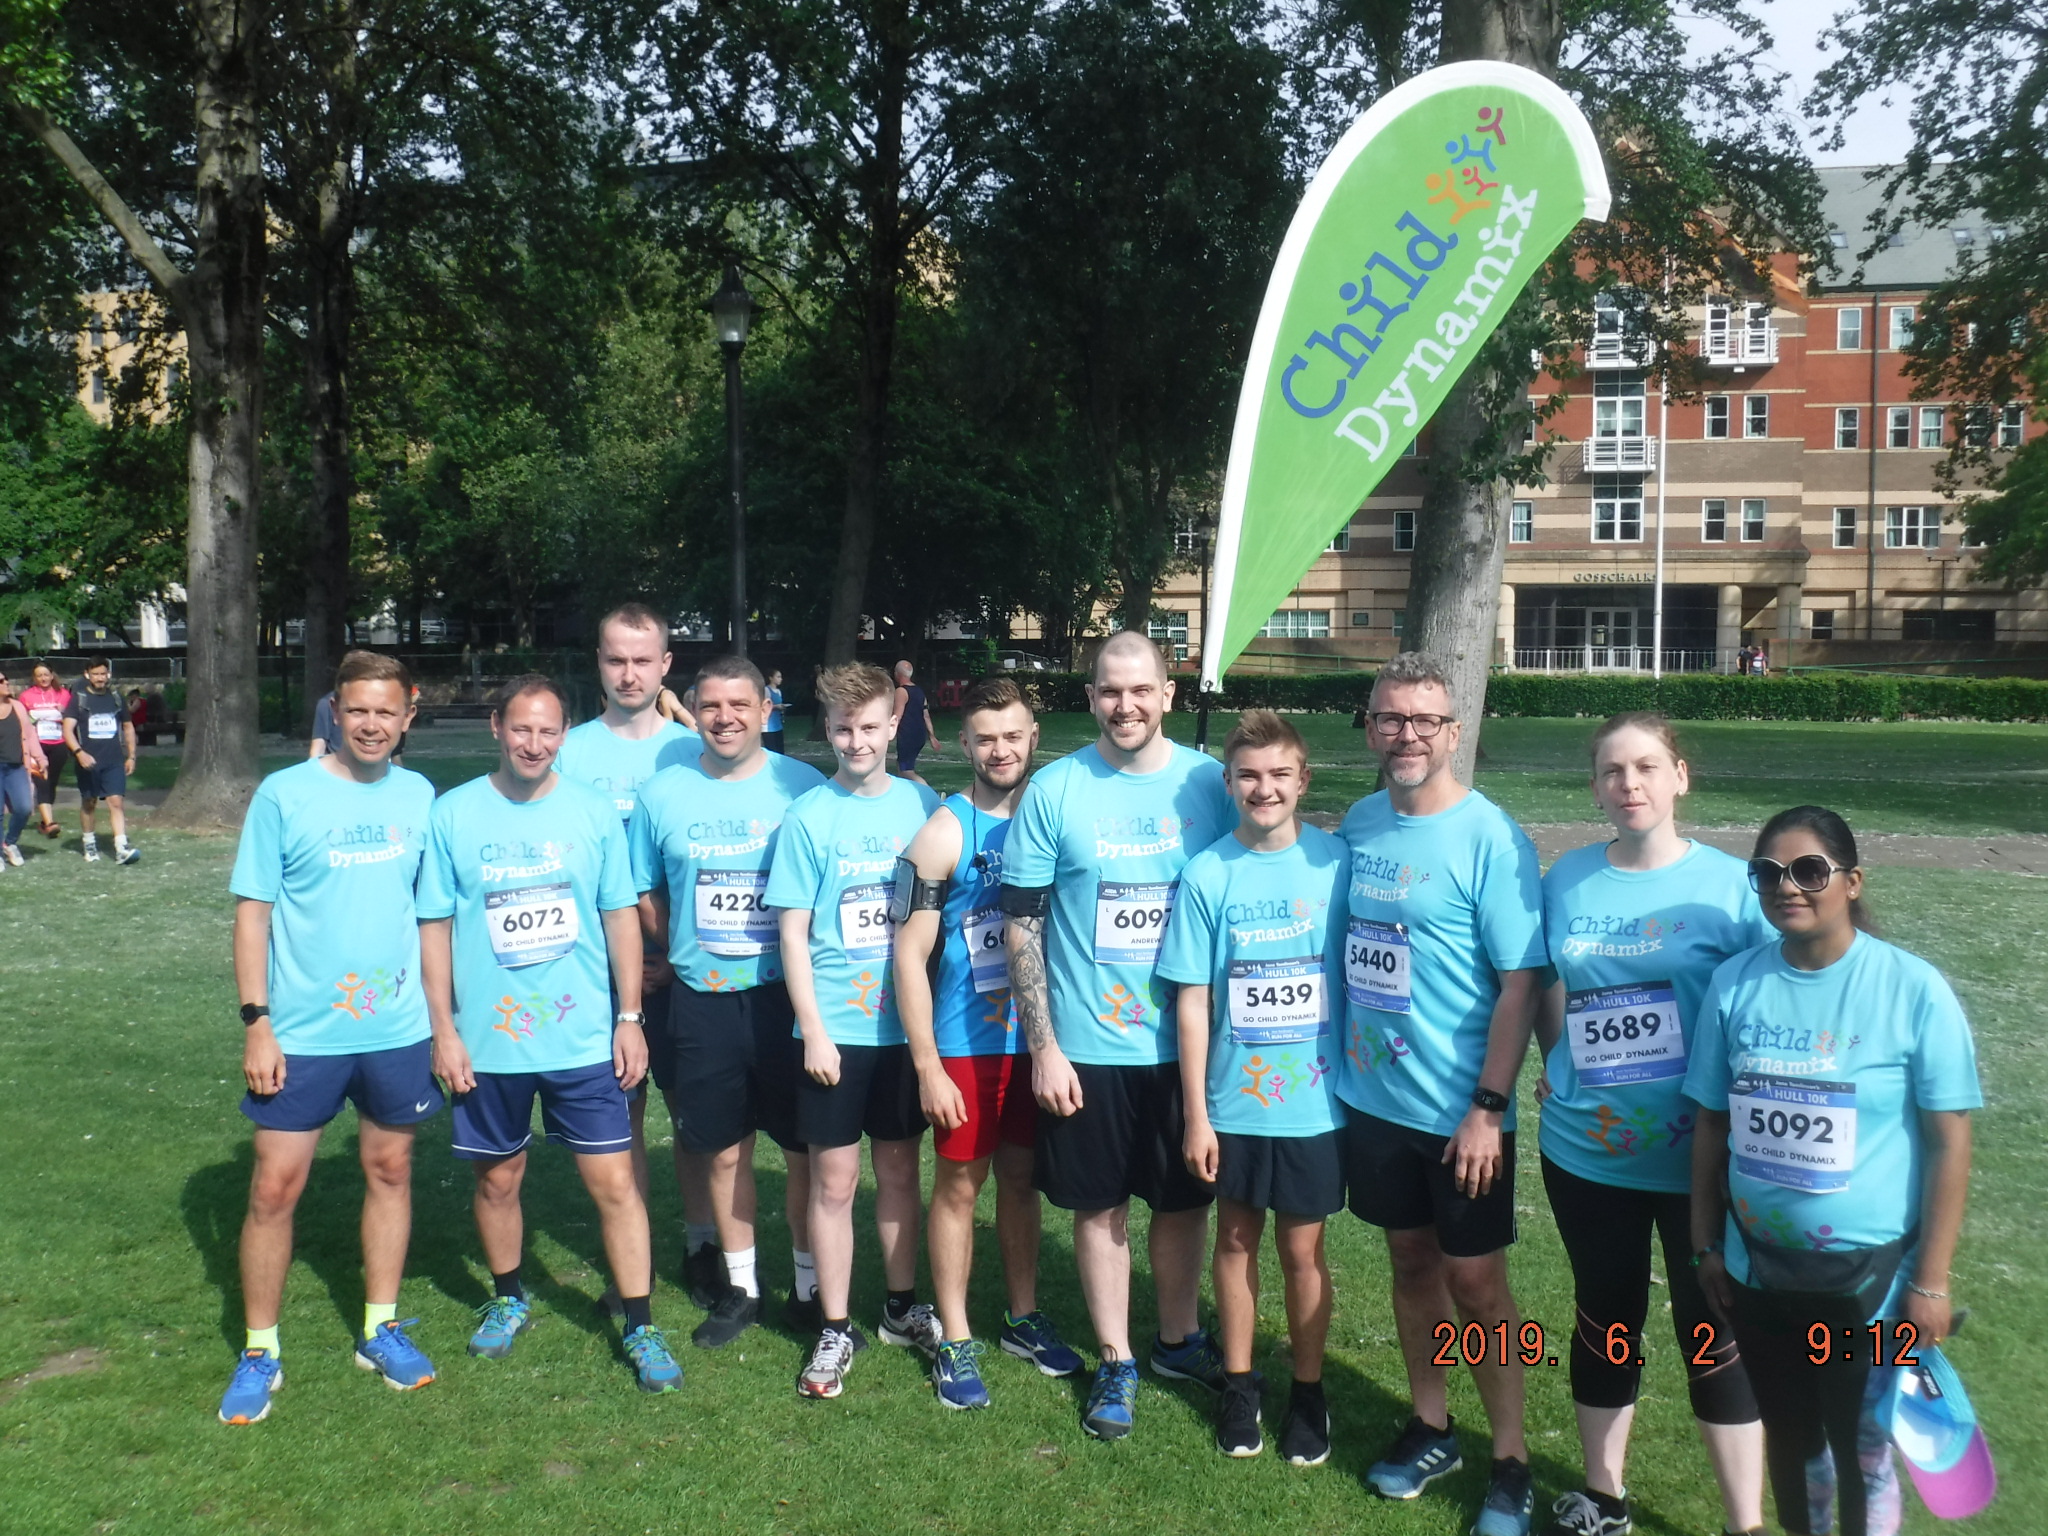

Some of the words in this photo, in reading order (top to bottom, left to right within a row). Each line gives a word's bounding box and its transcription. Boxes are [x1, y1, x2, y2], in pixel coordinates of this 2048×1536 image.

[1281, 210, 1459, 418] Child
[1334, 184, 1538, 463] Dynamix
[327, 825, 387, 847] Child
[688, 819, 747, 840] Child
[328, 843, 406, 868] Dynamix
[688, 835, 768, 860] Dynamix
[835, 836, 890, 857] Cild
[1095, 835, 1180, 859] Dynamix
[481, 860, 564, 882] Dynamix
[1354, 853, 1399, 882] Child
[729, 878, 750, 886] HULL
[1137, 892, 1157, 900] HULL
[503, 907, 565, 933] 6072
[1225, 900, 1291, 925] Child
[1229, 918, 1315, 947] Dynamix
[1362, 929, 1379, 940] HULL
[1380, 933, 1393, 942] 10K
[1568, 915, 1640, 937] Child
[516, 938, 535, 946] CHILD
[538, 933, 570, 943] DYNAMIX
[870, 934, 887, 942] CHILD
[1561, 937, 1663, 957] Dynamix
[1350, 944, 1396, 974] 5440
[1265, 969, 1289, 978] HULL
[1291, 967, 1307, 976] 10K
[1353, 975, 1367, 985] CHILD
[1368, 979, 1398, 991] DYNAMIX
[1246, 983, 1313, 1008] 5439
[1602, 996, 1630, 1008] HULL
[1632, 993, 1651, 1004] 10K
[1257, 1015, 1278, 1023] CHILD
[1281, 1012, 1317, 1022] DYNAMIX
[1585, 1012, 1661, 1044] 5689
[1737, 1024, 1812, 1052] Child
[1585, 1055, 1597, 1063] GO
[1600, 1053, 1622, 1062] CHILD
[1625, 1047, 1668, 1059] DYNAMIX
[1737, 1052, 1837, 1075] Dynamix
[1774, 1089, 1804, 1102] HULL
[1807, 1093, 1828, 1105] 10K
[1749, 1107, 1834, 1144] 5092
[1745, 1144, 1758, 1153] GO
[1762, 1147, 1785, 1158] CHILD
[1789, 1152, 1836, 1165] DYNAMIX
